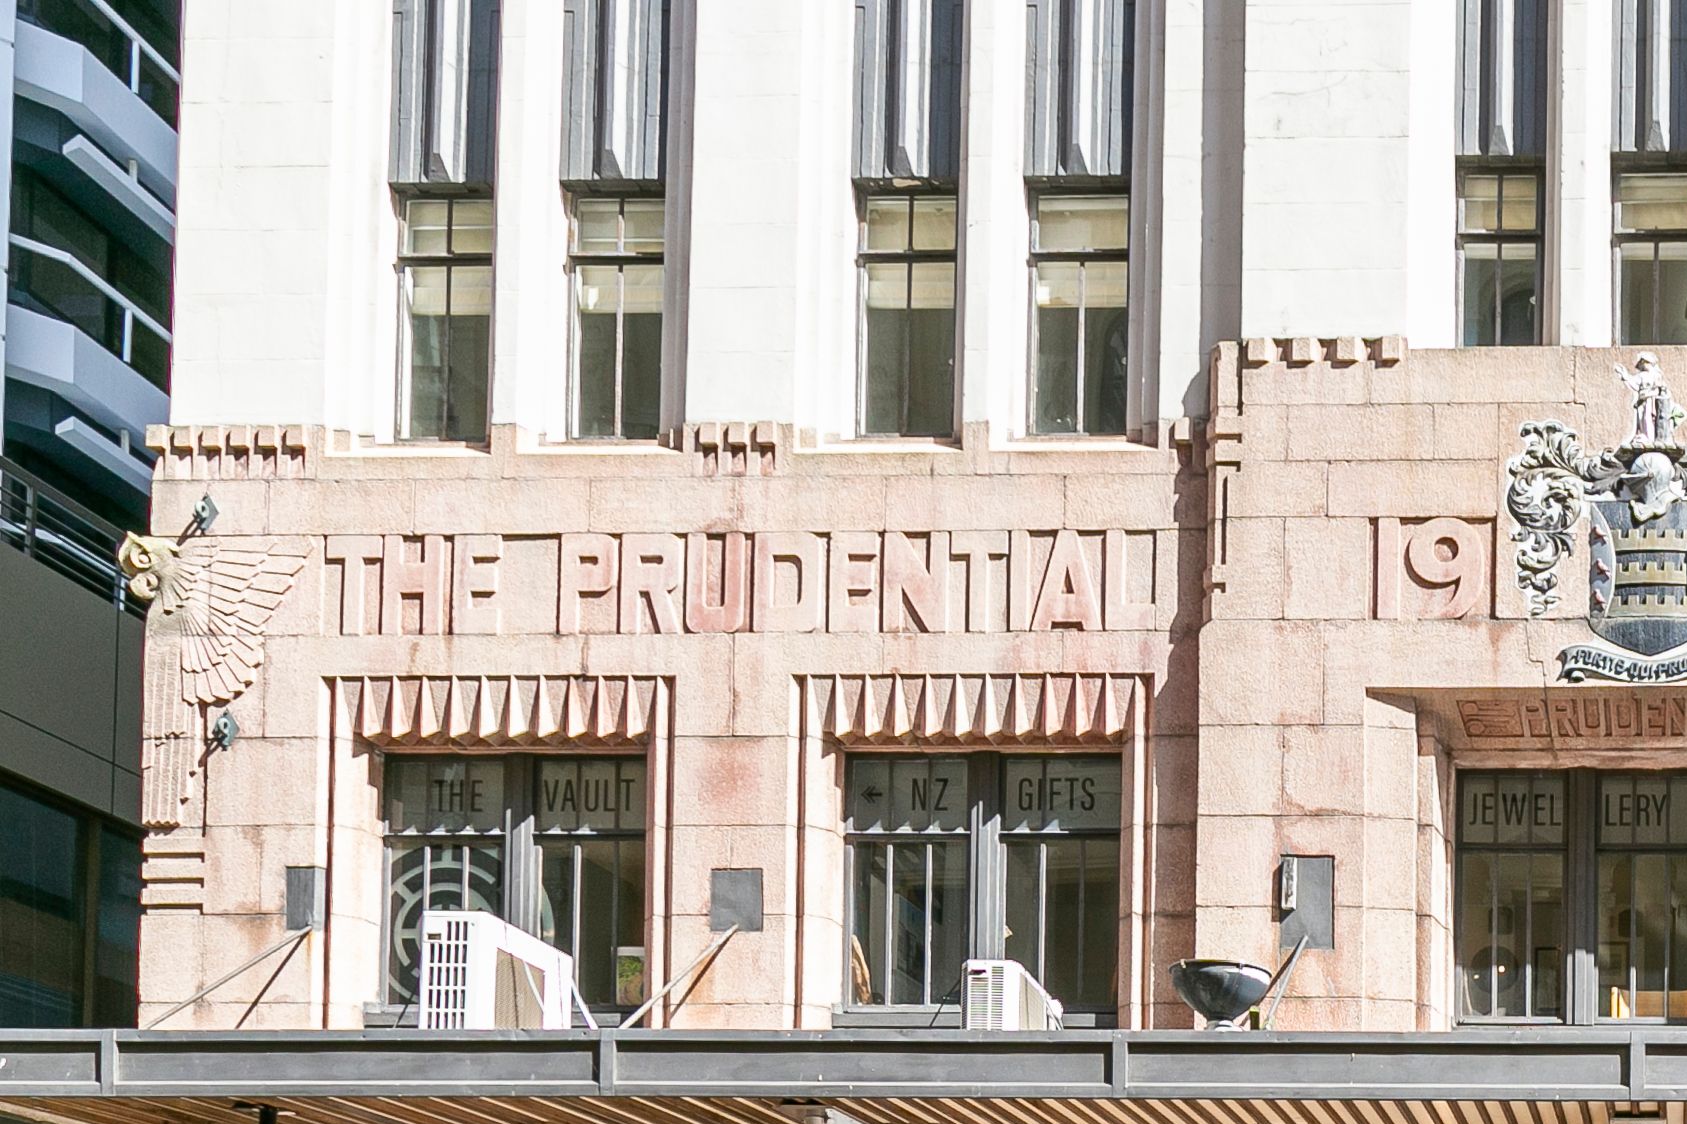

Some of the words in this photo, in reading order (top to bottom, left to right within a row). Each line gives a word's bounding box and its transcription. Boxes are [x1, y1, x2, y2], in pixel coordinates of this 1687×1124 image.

[324, 534, 504, 635] THE
[556, 529, 1156, 635] PRUDENTIAL
[433, 779, 484, 814] THE
[542, 777, 637, 814] VAULT
[910, 776, 949, 813] NZ
[1017, 776, 1096, 813] GIFTS
